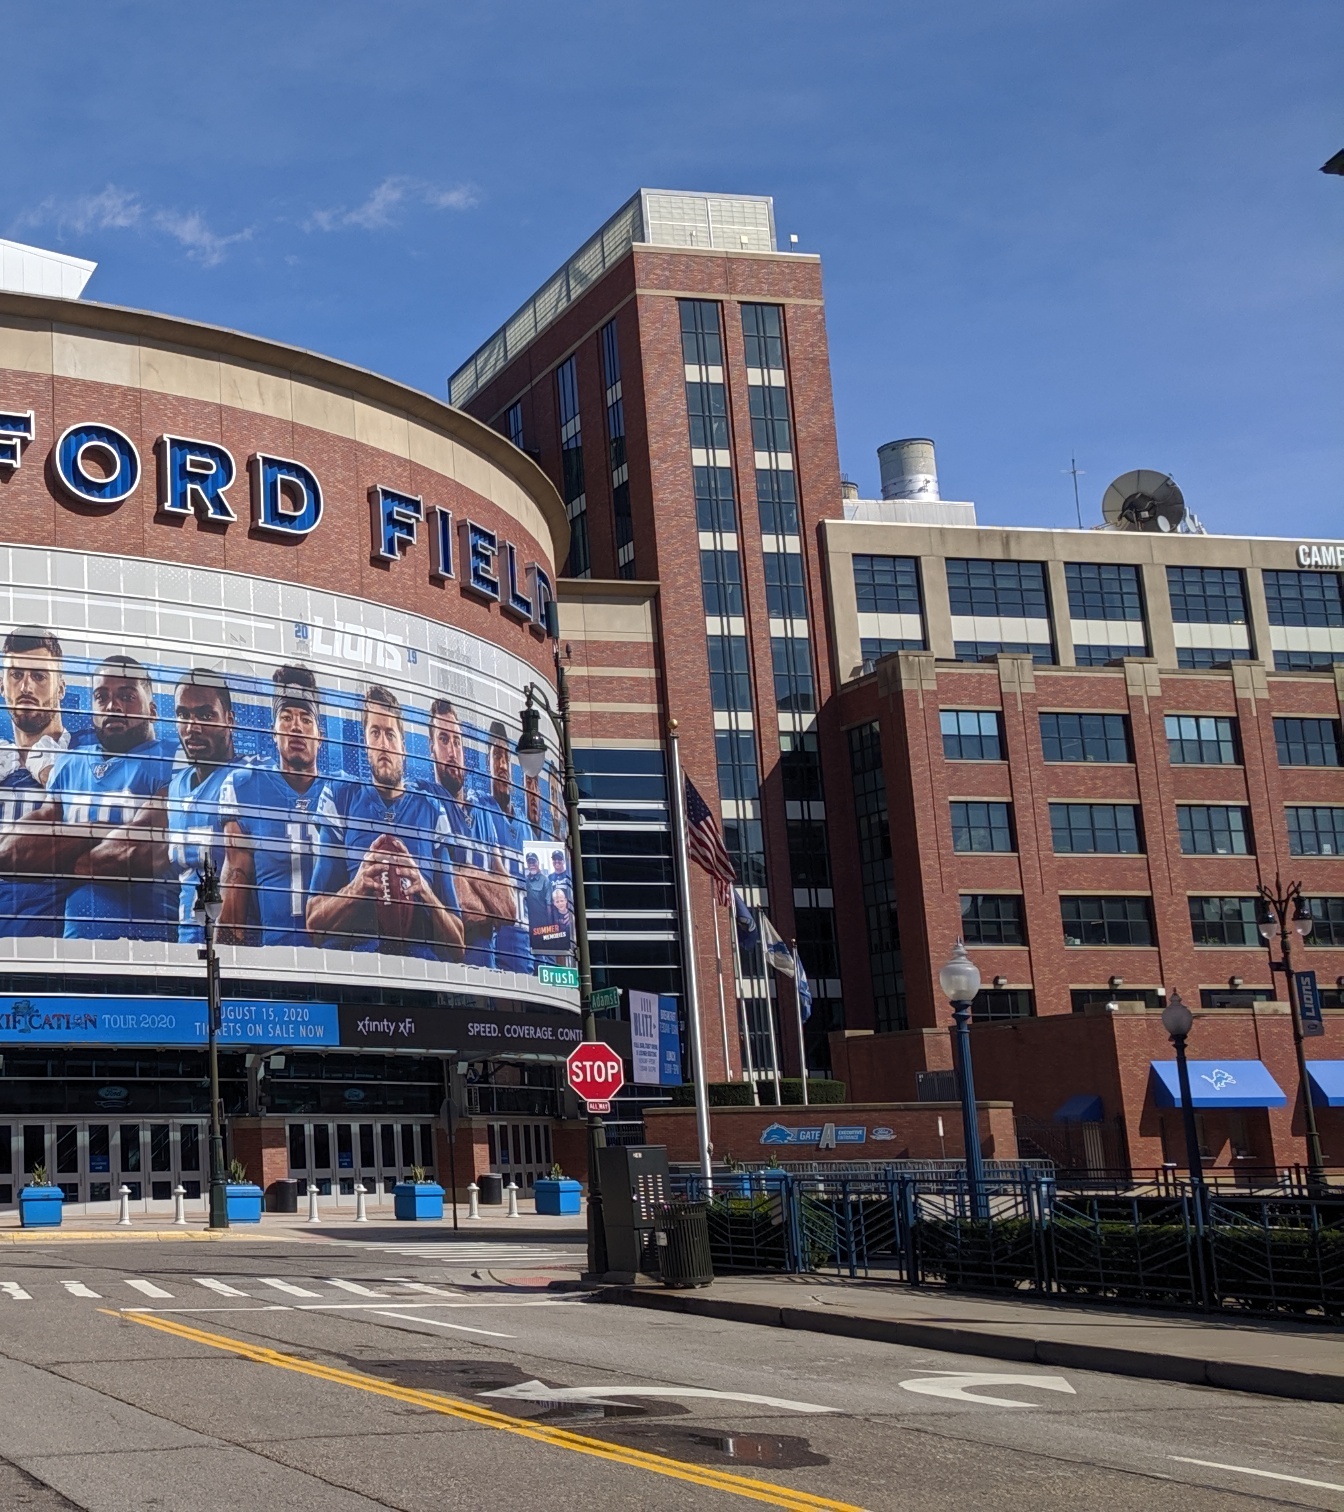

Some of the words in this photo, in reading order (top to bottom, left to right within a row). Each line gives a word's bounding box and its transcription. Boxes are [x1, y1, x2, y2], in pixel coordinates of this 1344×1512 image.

[367, 484, 555, 635] FIELD
[294, 622, 309, 639] 20
[406, 647, 418, 664] 19
[533, 924, 560, 936] SUMMER
[542, 969, 575, 985] Brush
[592, 993, 613, 1008] Adams
[101, 1014, 138, 1028] TOUR
[139, 1014, 176, 1028] 2020
[220, 1006, 256, 1020] UGUST
[262, 1007, 279, 1022] 15,
[283, 1008, 310, 1021] 2020
[194, 1022, 241, 1036] TIKETS
[247, 1023, 263, 1036] ON
[268, 1023, 294, 1037] SALE
[299, 1024, 325, 1038] NOW
[356, 1016, 396, 1036] xfinity
[467, 1022, 501, 1037] SPEED.
[504, 1024, 556, 1040] COVERAGE.
[571, 1060, 619, 1083] STOP
[799, 1130, 821, 1141] GATE
[819, 1122, 836, 1148] A
